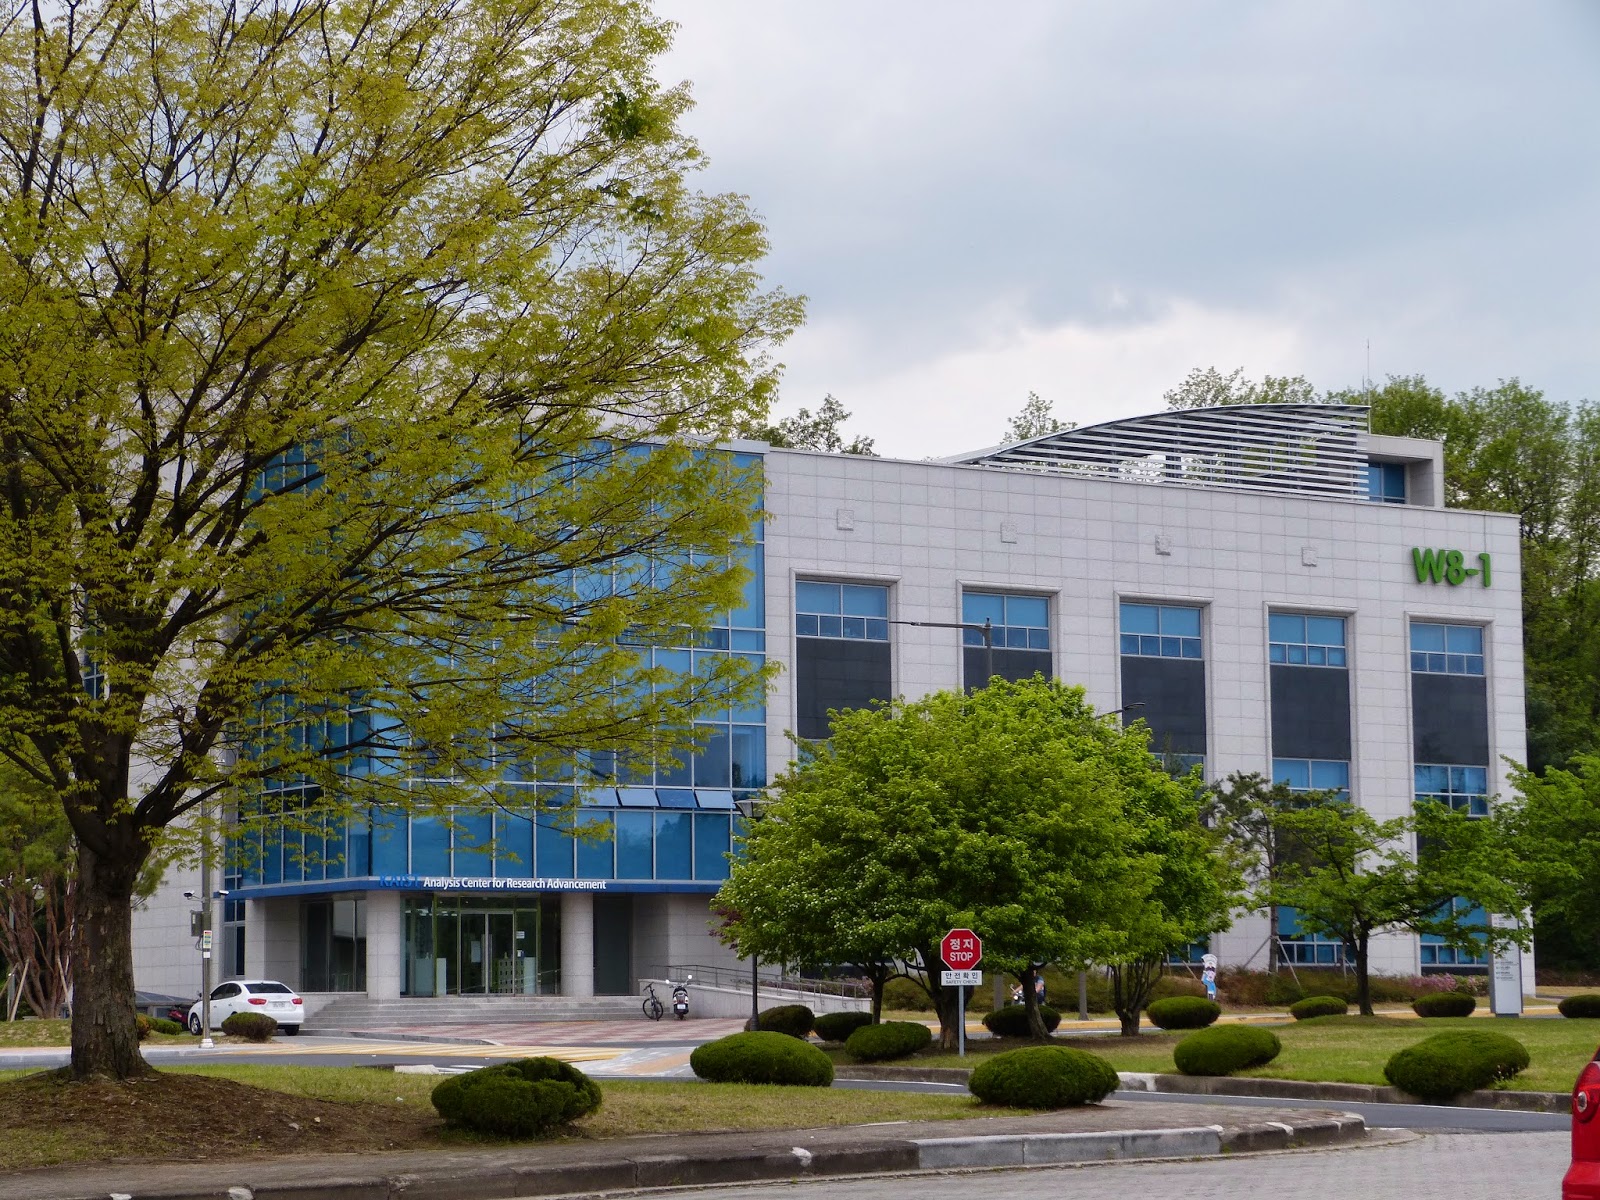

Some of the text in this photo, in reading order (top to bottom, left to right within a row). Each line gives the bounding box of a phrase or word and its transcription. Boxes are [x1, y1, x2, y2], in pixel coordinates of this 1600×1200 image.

[1412, 547, 1491, 587] W8-1
[379, 873, 607, 890] KAIST Analysis Center for Research Advancement
[950, 952, 974, 962] STOP
